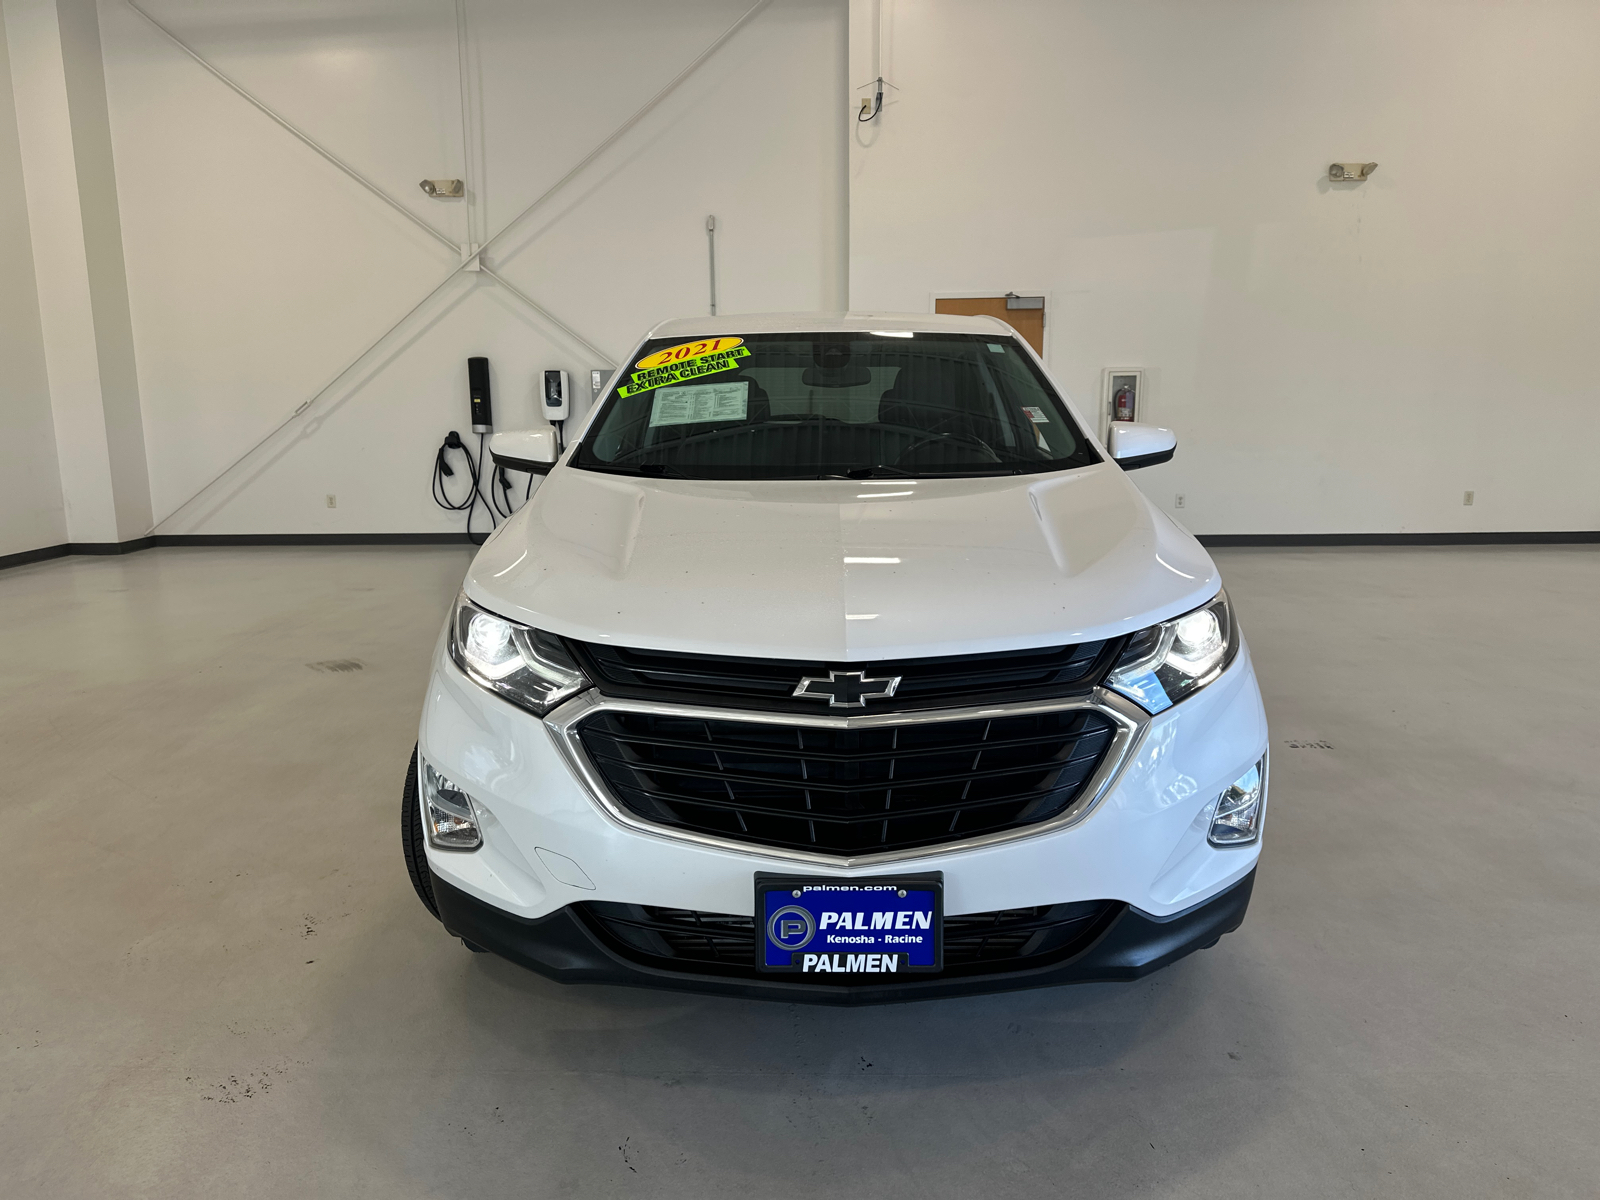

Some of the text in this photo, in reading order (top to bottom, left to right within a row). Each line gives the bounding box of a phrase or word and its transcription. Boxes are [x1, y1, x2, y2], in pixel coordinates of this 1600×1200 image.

[657, 338, 722, 365] 2021
[636, 348, 745, 381] REMOTE START
[626, 359, 730, 394] EXTRA CLEAN
[803, 884, 897, 892] palmen.com
[780, 920, 806, 938] P
[819, 911, 932, 930] PALMEN
[826, 935, 875, 944] Kenosha
[884, 935, 923, 944] Racine
[802, 954, 898, 973] PALMEN
